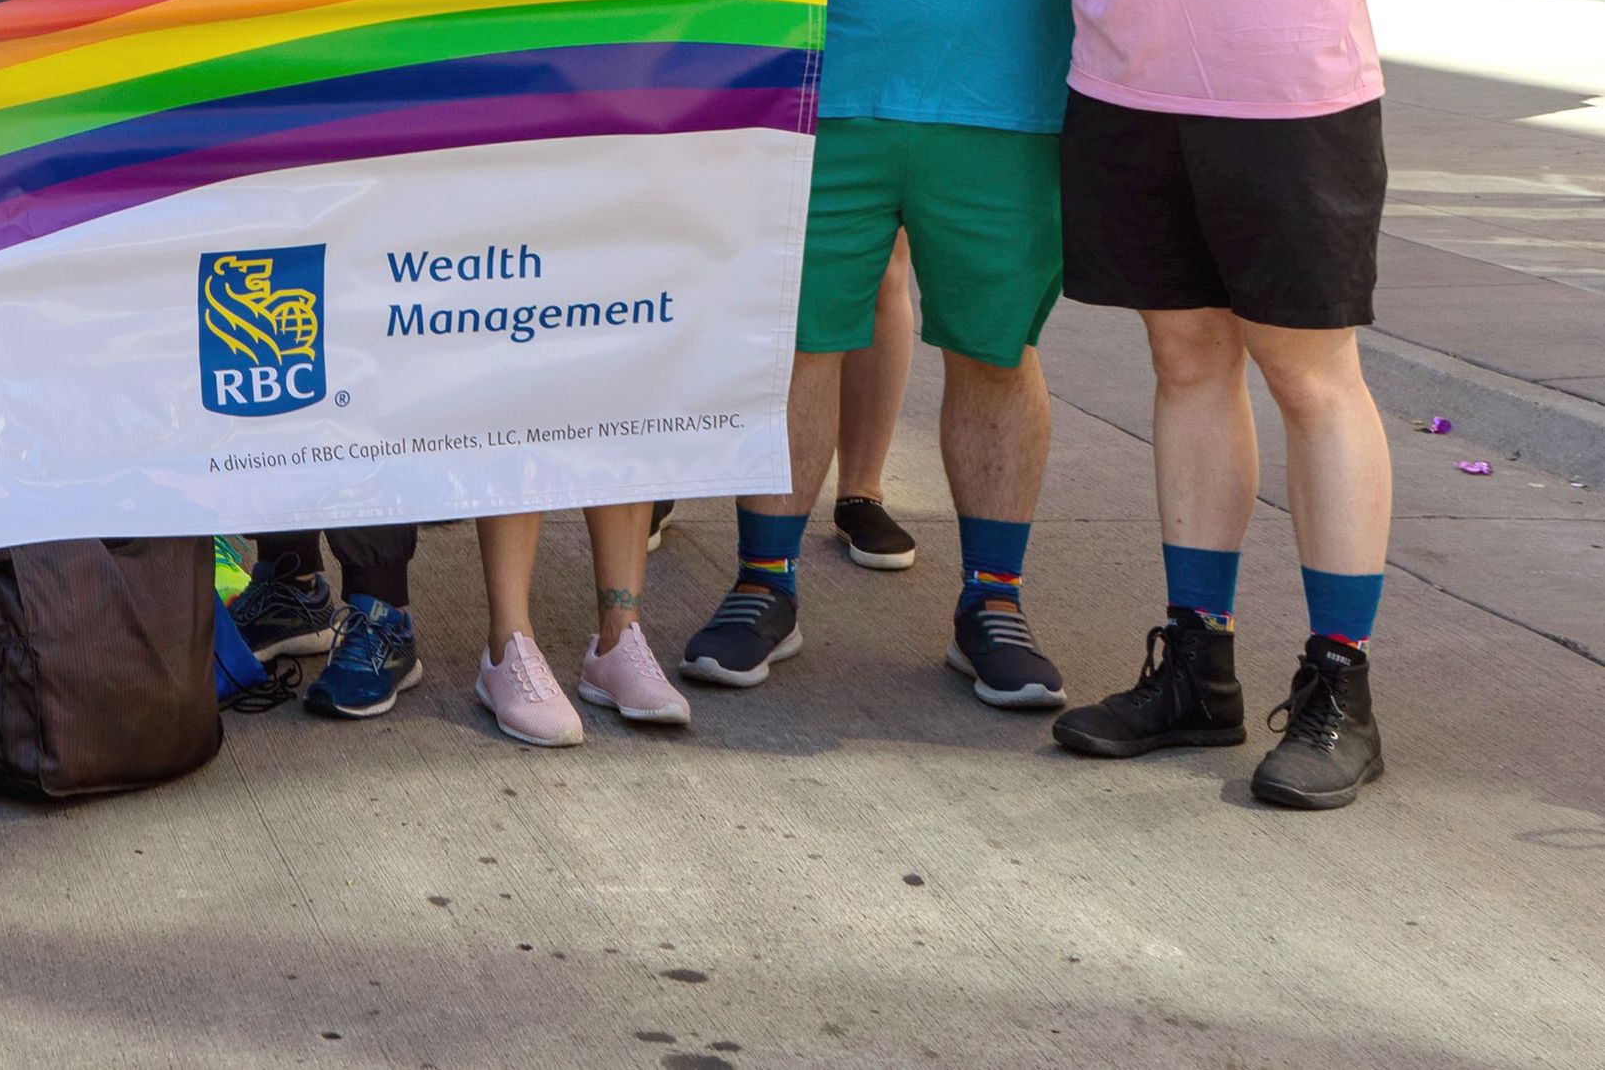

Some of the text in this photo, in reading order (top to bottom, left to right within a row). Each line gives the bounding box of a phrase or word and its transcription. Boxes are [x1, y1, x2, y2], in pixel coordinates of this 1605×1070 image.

[387, 244, 542, 284] Wealth
[386, 290, 674, 343] Management
[213, 361, 316, 407] RBC
[209, 457, 221, 473] A
[224, 452, 287, 472] division
[291, 446, 308, 465] of
[311, 444, 345, 463] RBC
[348, 437, 406, 462] Capital
[411, 433, 483, 453] Markets,
[526, 424, 594, 443] Member
[598, 413, 745, 437] NYSE/FINRA/SIPC.
